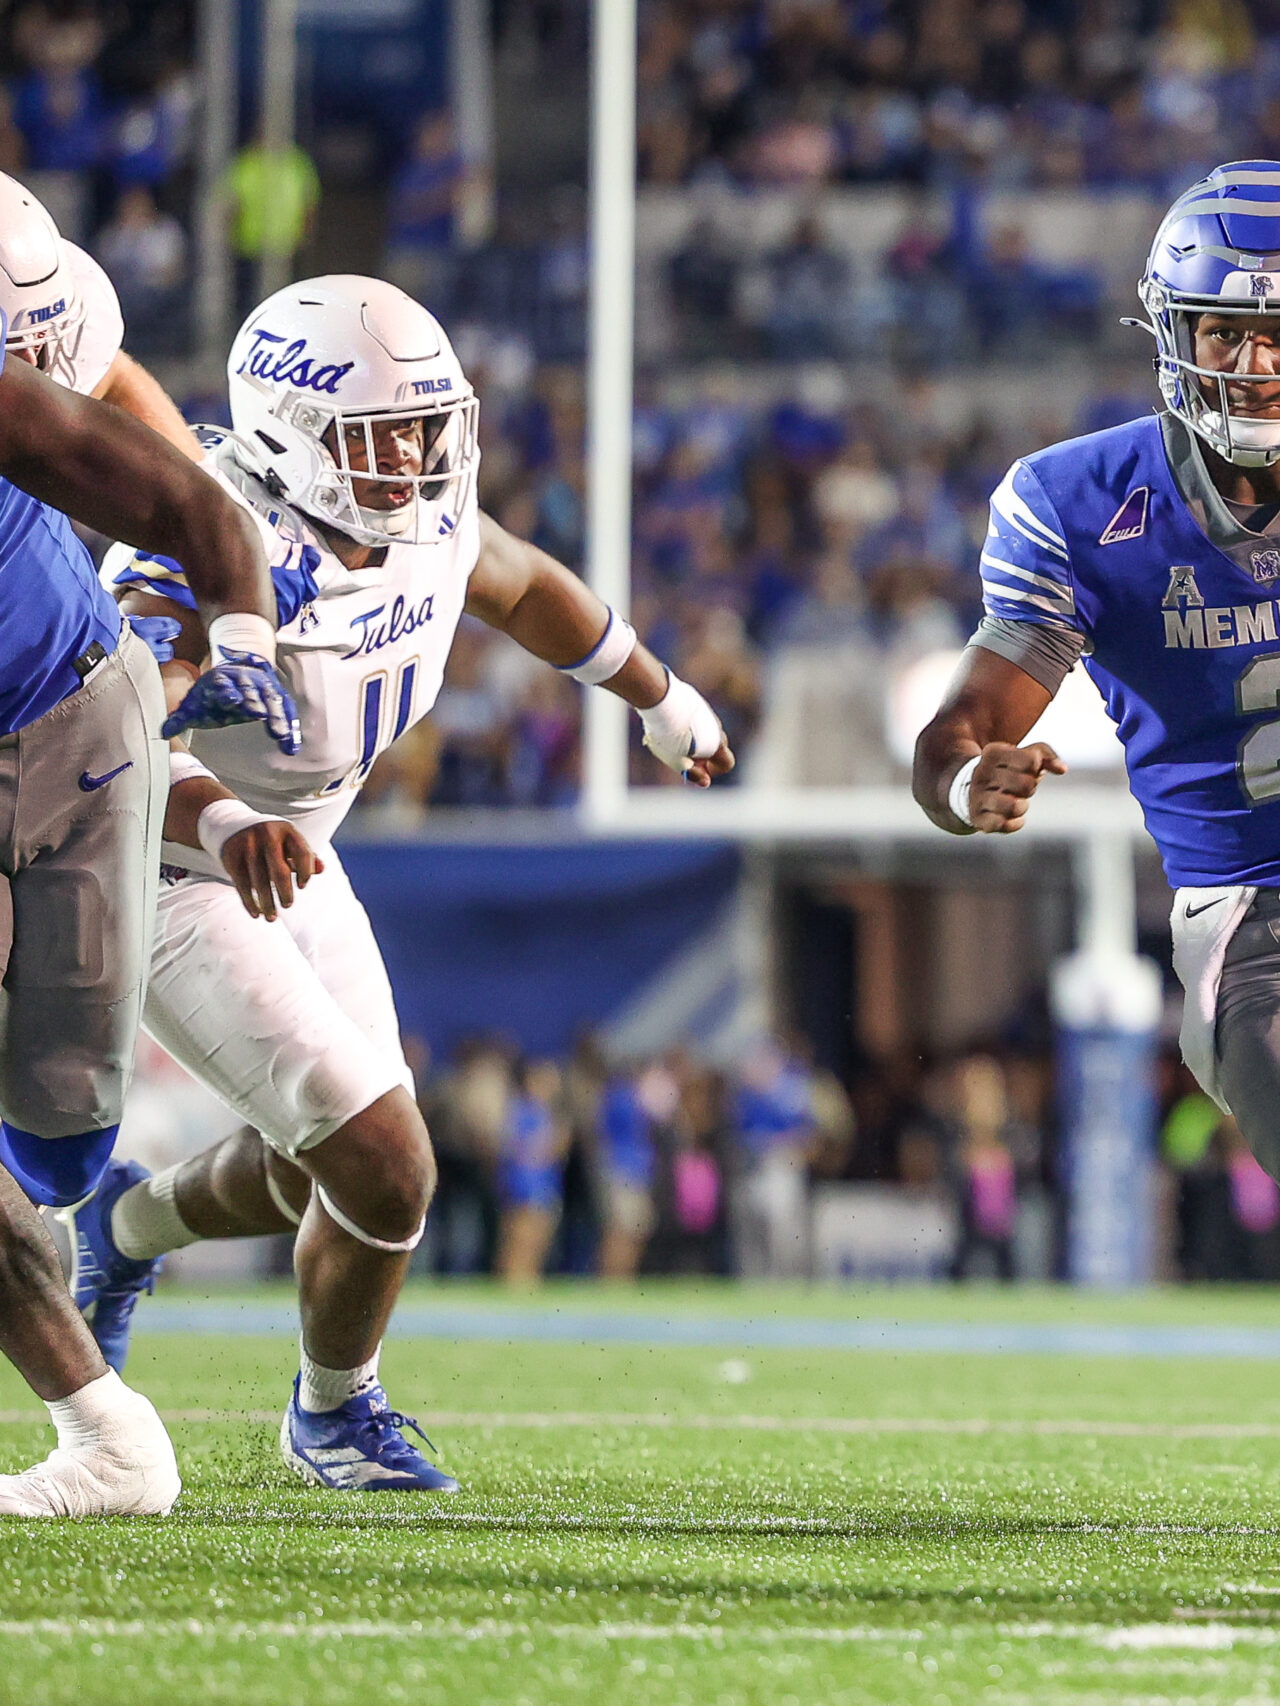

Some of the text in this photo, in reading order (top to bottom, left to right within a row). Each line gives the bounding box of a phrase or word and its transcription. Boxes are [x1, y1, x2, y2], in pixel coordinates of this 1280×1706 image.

[28, 298, 66, 325] TULSA
[236, 329, 356, 394] Tulsa
[411, 377, 453, 396] TULSA
[1161, 565, 1204, 607] A
[340, 593, 435, 661] Tulsa
